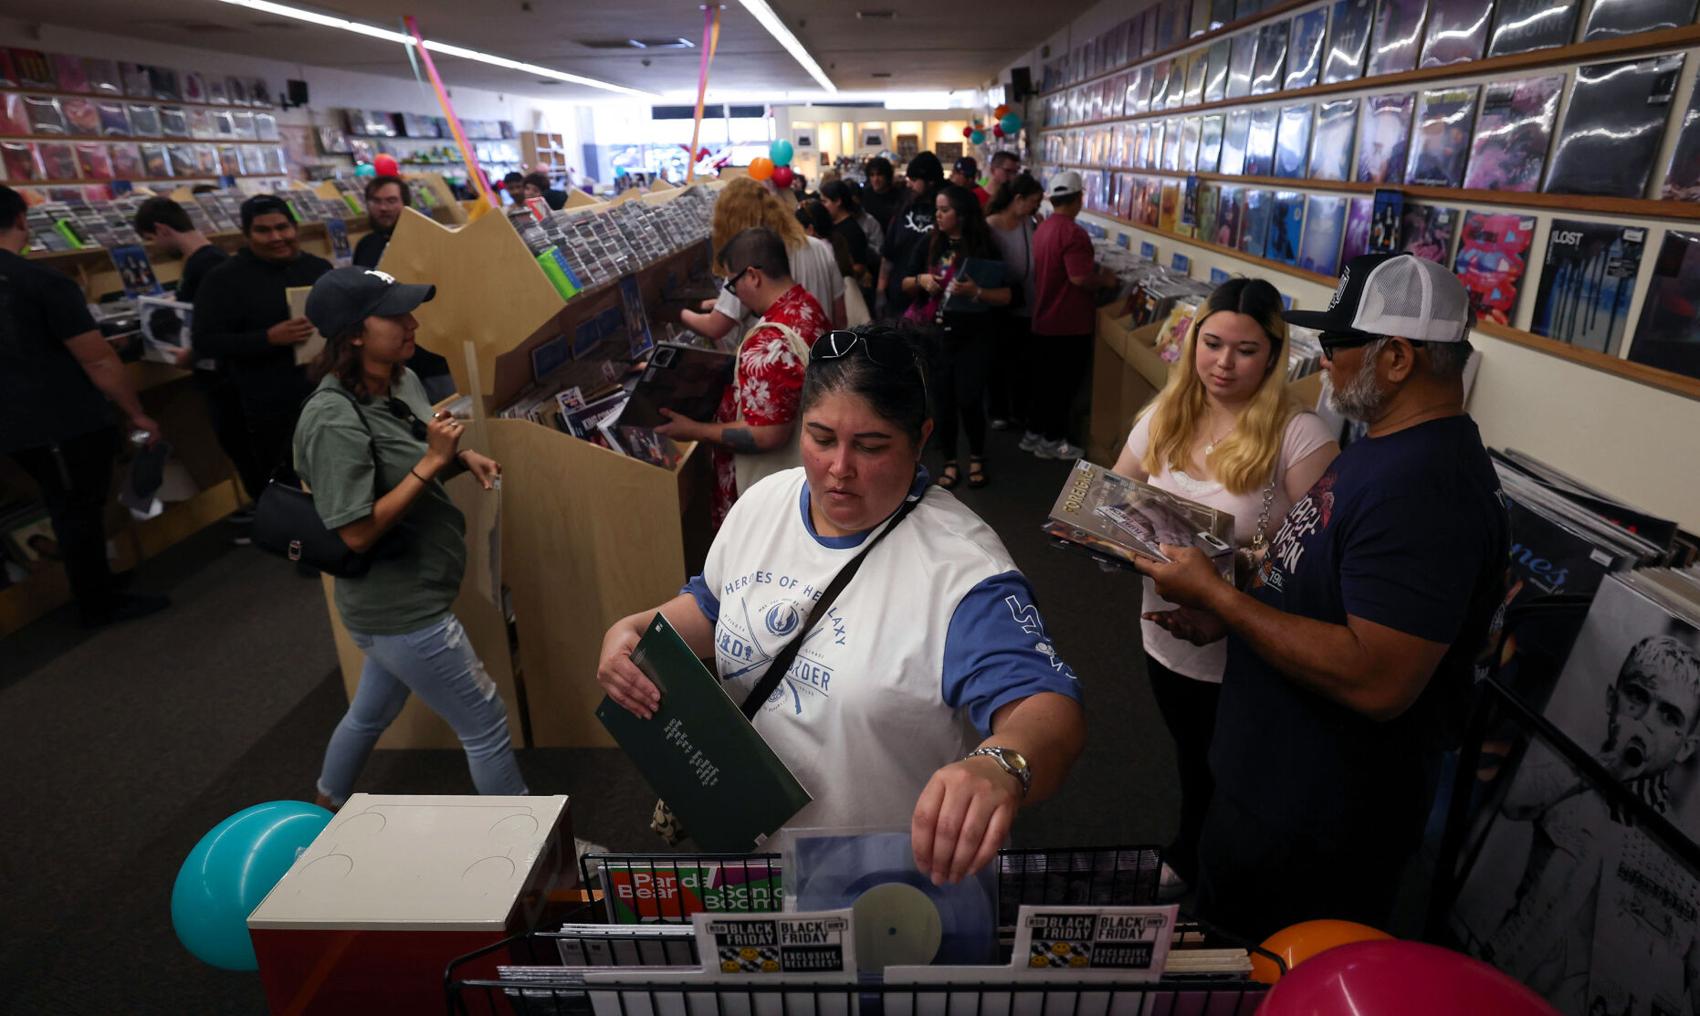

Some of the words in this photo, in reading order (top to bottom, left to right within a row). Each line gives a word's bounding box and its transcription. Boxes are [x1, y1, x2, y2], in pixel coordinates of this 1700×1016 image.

[1553, 230, 1583, 246] LOST
[1063, 469, 1098, 514] FOREIGNE
[1509, 543, 1569, 586] nes
[779, 575, 799, 590] OF
[802, 584, 823, 602] HE
[787, 658, 832, 692] RDER
[617, 883, 677, 899] Bear
[704, 894, 778, 910] Boom
[781, 921, 824, 933] BLACK
[1049, 916, 1093, 928] BLACK
[1100, 916, 1143, 928] BLACK
[727, 922, 773, 935] BLACK
[1042, 928, 1092, 939] FRIDAY
[1098, 927, 1146, 939] FRIDAY
[726, 934, 775, 945] FRIDAY
[782, 932, 828, 943] FRIDAY
[784, 951, 837, 961] EXCLUSIVE
[1094, 947, 1148, 956] EXCLUSIVE
